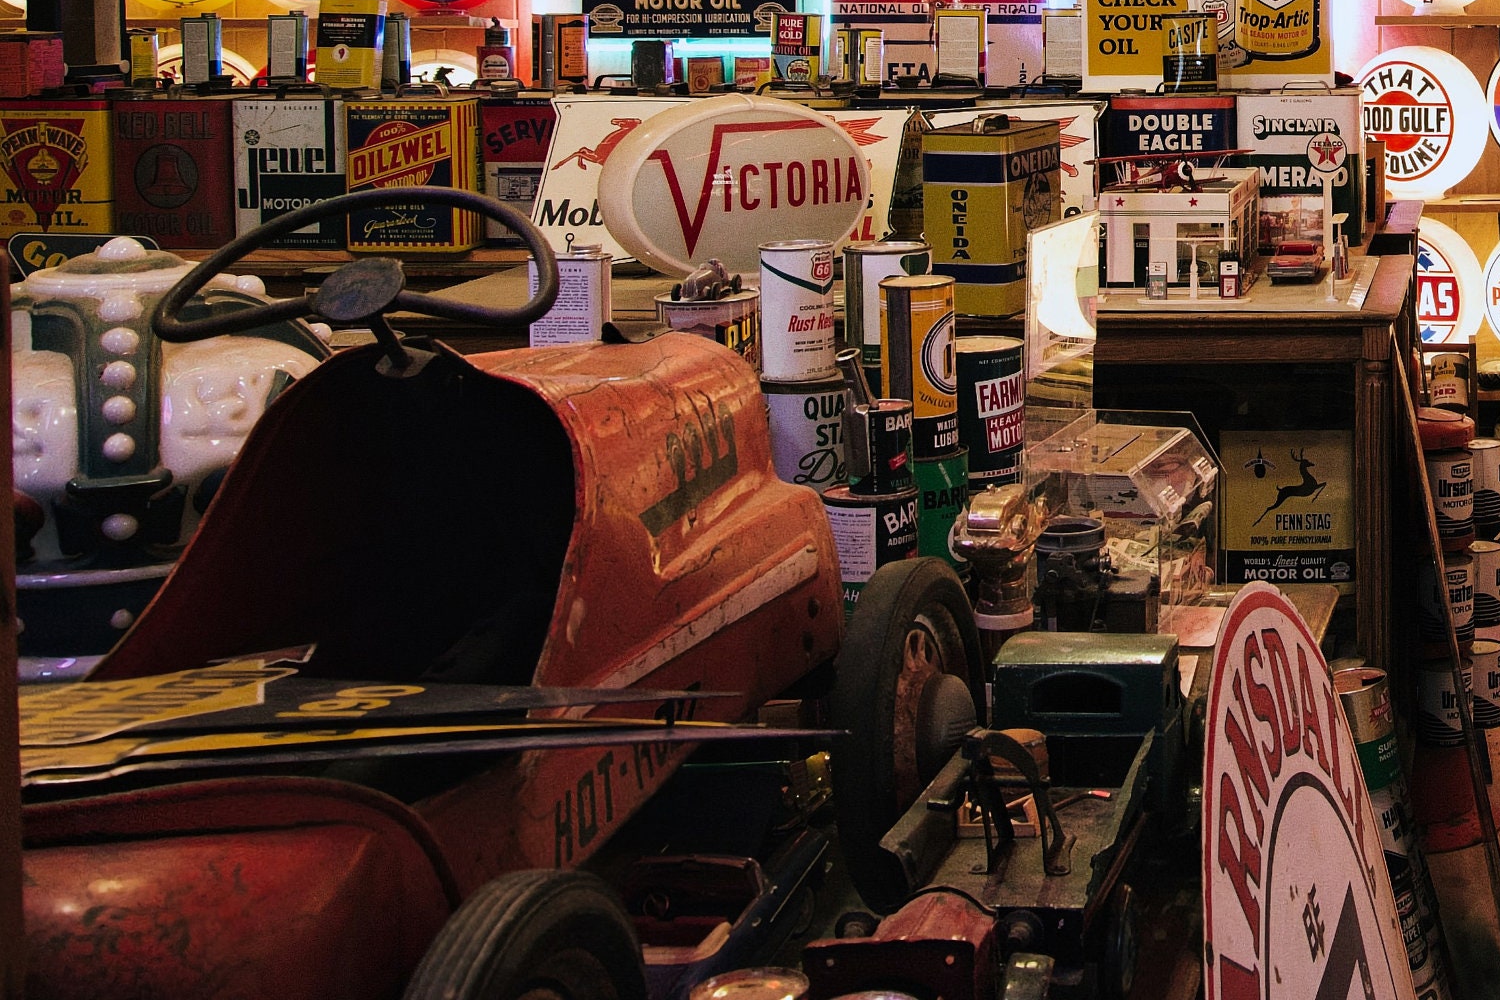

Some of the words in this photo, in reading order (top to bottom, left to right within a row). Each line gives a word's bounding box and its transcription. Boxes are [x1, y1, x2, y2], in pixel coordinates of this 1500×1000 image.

[840, 3, 906, 14] NATIONAL
[912, 3, 929, 14] OL
[998, 3, 1037, 15] ROAD
[626, 13, 639, 24] FOR
[641, 13, 702, 24] HI-COMPRESSION
[704, 13, 751, 24] LUBRICATION
[779, 18, 804, 28] PURE
[1099, 14, 1164, 31] YOUR
[1238, 7, 1309, 30] Trop-Artic
[779, 30, 803, 40] GOLD
[1168, 20, 1209, 49] CASITE
[1099, 38, 1139, 55] OIL
[1364, 68, 1436, 98] THAT
[118, 112, 158, 139] RED
[163, 112, 213, 139] BELL
[1129, 114, 1213, 131] DOUBLE
[1252, 115, 1338, 137] SINCLAIR
[1364, 106, 1392, 133] OOD
[1399, 106, 1448, 133] GULF
[1139, 134, 1203, 151] EAGLE
[353, 129, 447, 180] OILZWEL
[1010, 149, 1058, 177] ONEIDA
[645, 119, 866, 259] VICTORIA
[788, 316, 814, 332] Rust
[1275, 514, 1303, 531] PENN
[1305, 513, 1332, 531] STAG
[1250, 535, 1269, 546] 100%
[1270, 535, 1286, 545] PURE
[1287, 534, 1332, 546] PENNSYLVANIA
[1244, 557, 1270, 566] WORLD'S
[1272, 553, 1299, 568] finest
[1300, 556, 1327, 567] QUALITY
[1244, 568, 1297, 580] MOTOR
[1302, 567, 1327, 580] OIL
